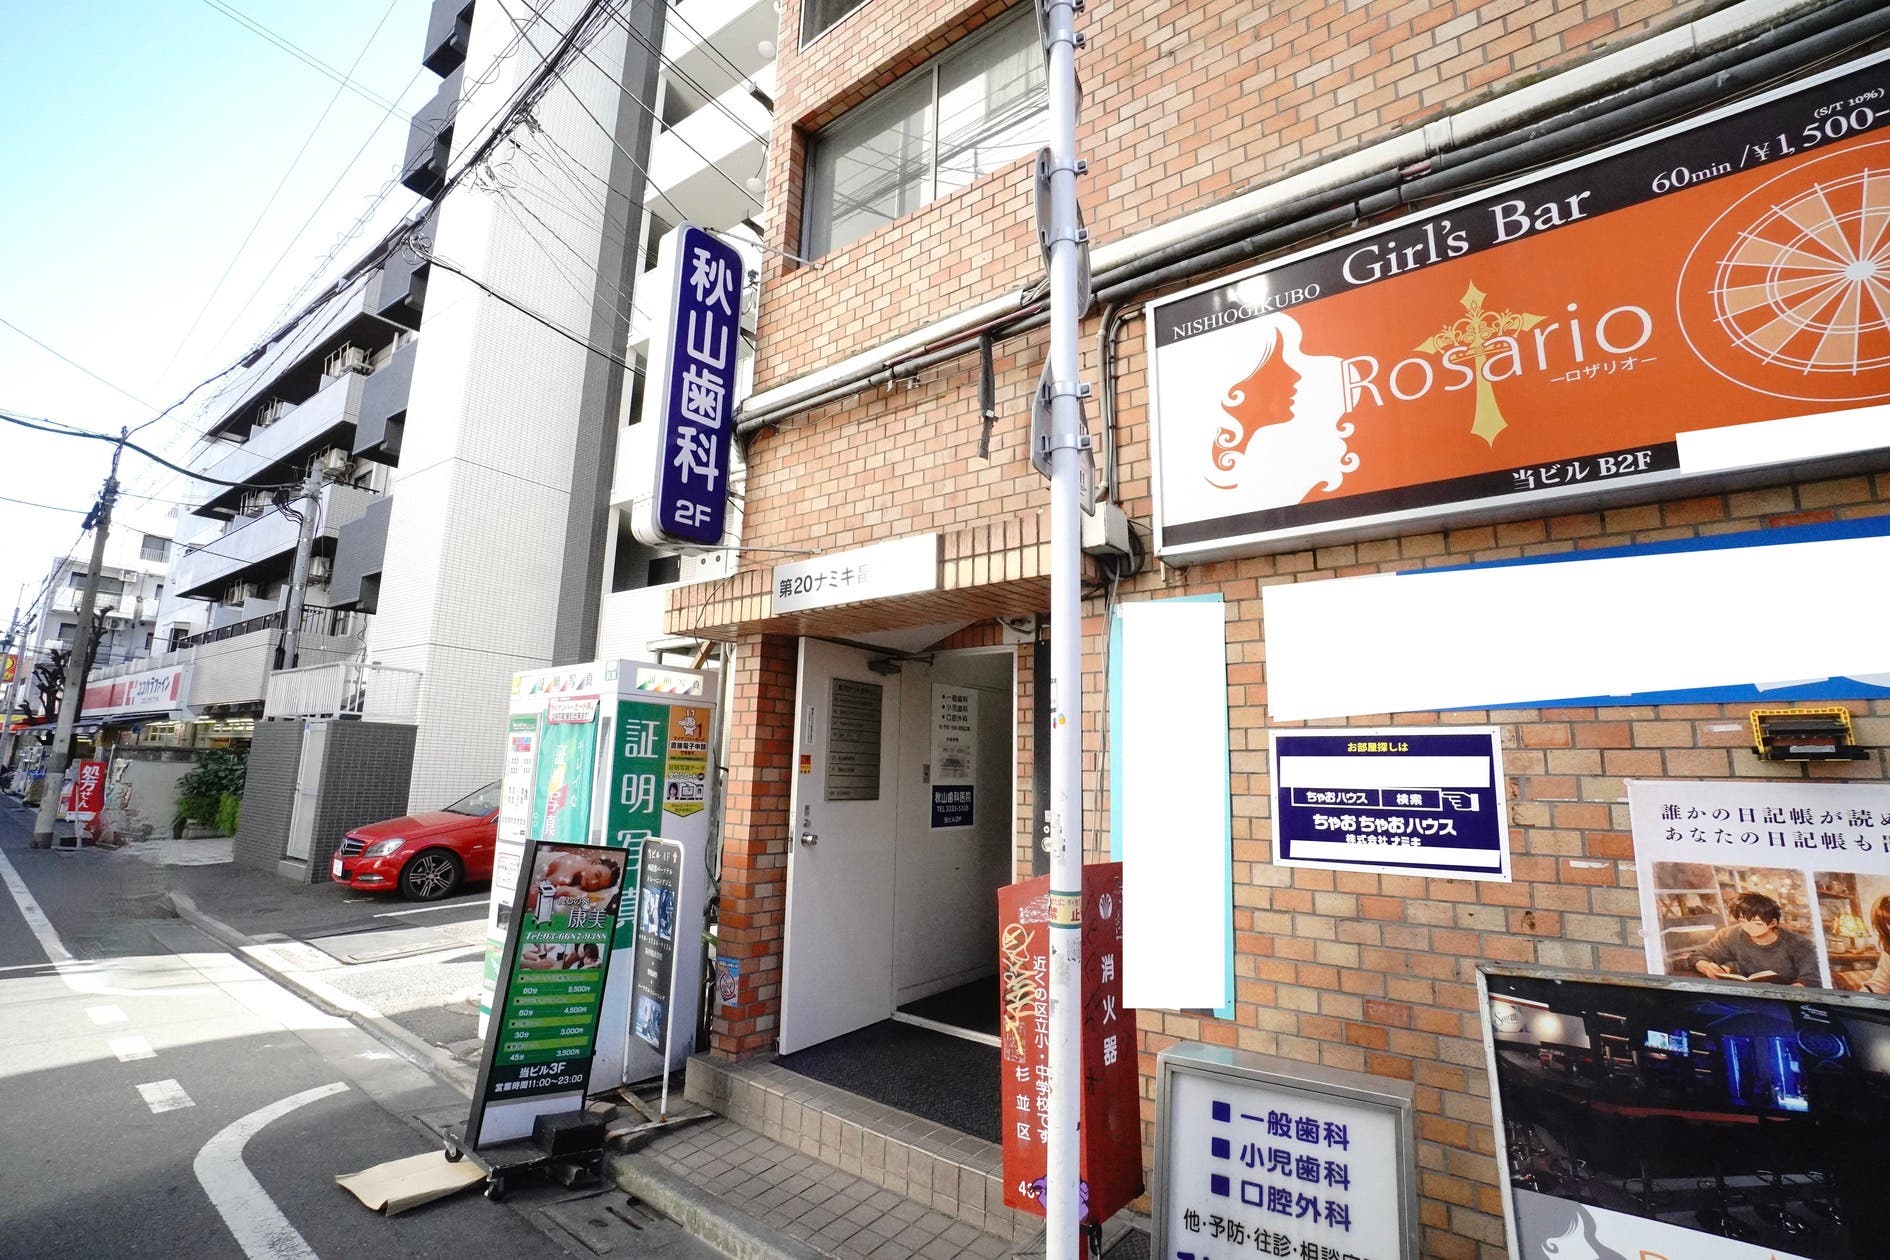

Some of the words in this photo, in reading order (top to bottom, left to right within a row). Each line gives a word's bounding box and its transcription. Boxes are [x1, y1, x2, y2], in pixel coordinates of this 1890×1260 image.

[1849, 87, 1885, 107] 10%)
[1651, 162, 1732, 194] 60min
[1342, 219, 1470, 285] Girl's
[1488, 190, 1592, 245] Bar
[1172, 283, 1321, 340] NISHIOGIKUBO
[673, 246, 734, 493] 秋山歯科
[1342, 303, 1653, 413] Rosario
[1511, 462, 1590, 490] 当ビル
[1598, 450, 1653, 478] B2F
[674, 499, 711, 528] 2F
[1347, 742, 1409, 753] お部屋探しは
[78, 765, 100, 808] 処方せん
[935, 791, 972, 803] 秋山歯科医院
[1306, 791, 1368, 804] ちゃおハウス
[1396, 793, 1423, 806] 検索
[567, 907, 607, 929] 康美
[1101, 953, 1118, 1066] 消火器
[519, 1062, 566, 1078] 当ビル3F
[1015, 1065, 1031, 1141] 杉並区
[1240, 1110, 1350, 1151] 一般歯科
[1239, 1142, 1351, 1191] 小児歯科
[1240, 1180, 1352, 1233] 口腔外科
